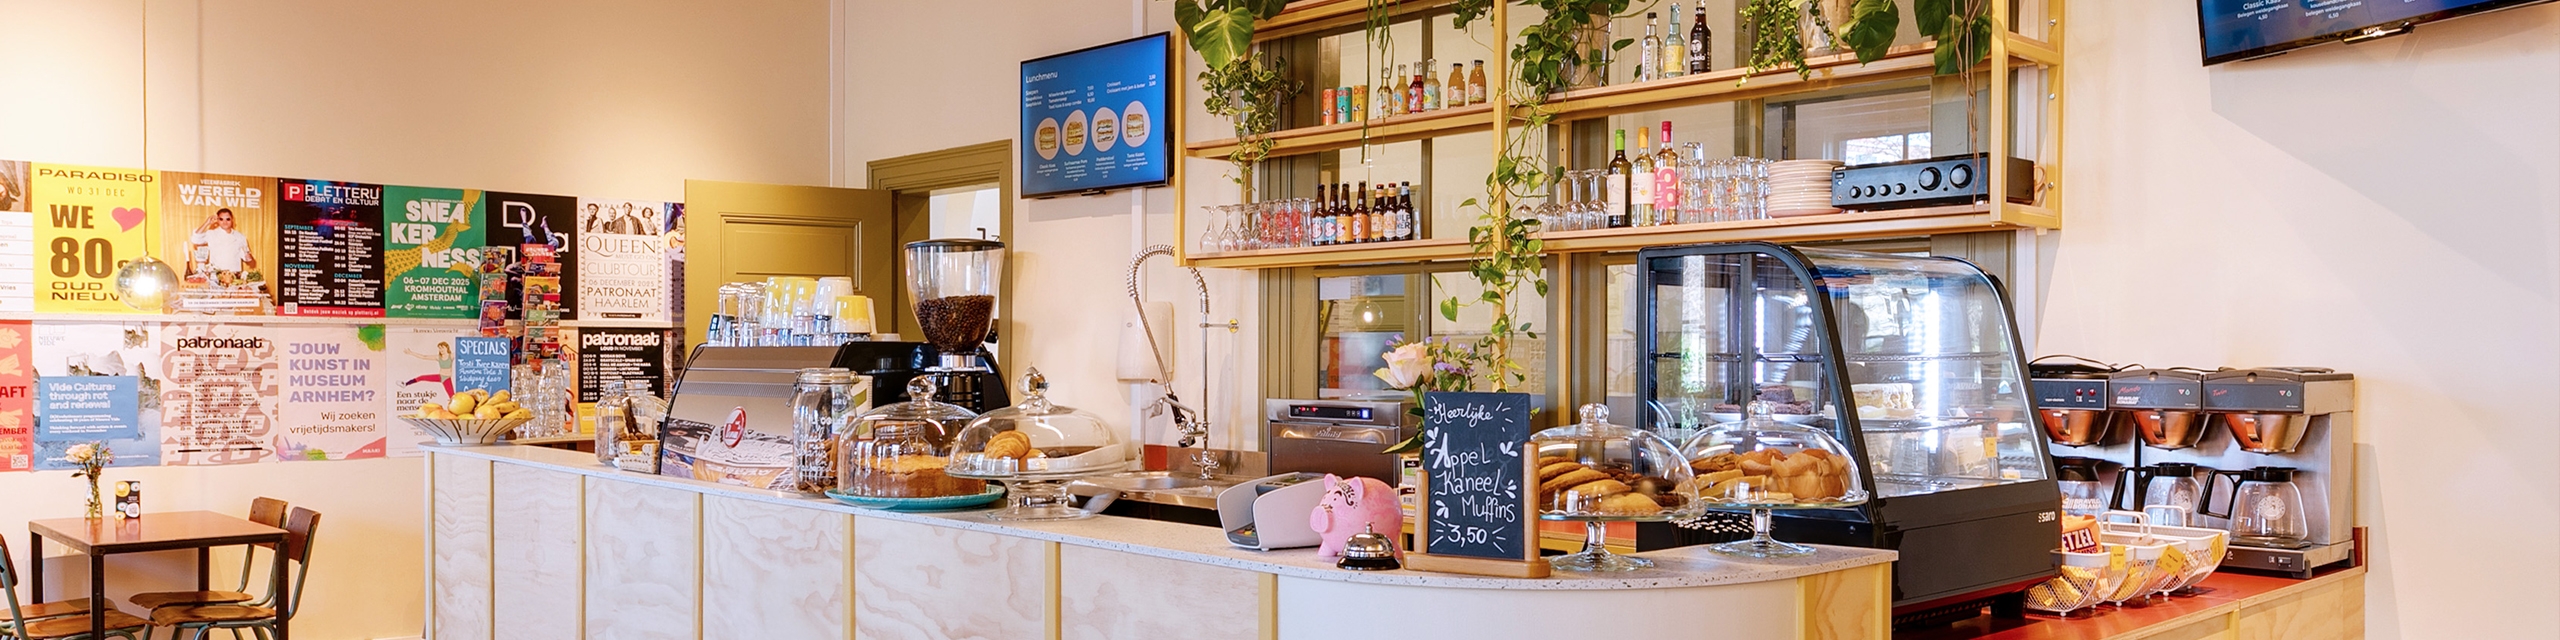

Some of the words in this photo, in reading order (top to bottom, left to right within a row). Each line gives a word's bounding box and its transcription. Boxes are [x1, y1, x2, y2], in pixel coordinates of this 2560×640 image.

[2243, 0, 2264, 10] Classic
[1025, 71, 1058, 84] Lunchmenu
[39, 168, 153, 182] PARADISO
[67, 186, 82, 195] WO
[88, 188, 100, 196] 31
[106, 188, 125, 197] DEC
[178, 184, 262, 199] WERELD
[289, 186, 300, 199] P
[180, 194, 223, 207] VAN
[225, 197, 260, 208] WIE
[305, 195, 331, 203] DEBAT
[333, 196, 343, 204] EN
[345, 198, 380, 206] CULTUUR
[50, 204, 94, 229] WE
[405, 200, 465, 223] SNEA
[391, 222, 437, 245] KER
[585, 235, 656, 257] QUEEN
[421, 247, 480, 269] NESS
[586, 261, 656, 277] CLUBTOUR
[52, 281, 103, 291] OUD
[432, 277, 449, 285] DEC
[451, 278, 470, 286] 2025
[404, 285, 469, 294] KROMHOUTHAL
[587, 287, 657, 298] PATRONAAT
[411, 293, 462, 302] AMSTERDAM
[594, 298, 649, 308] HAARLEM
[177, 336, 262, 351] patronaat
[582, 331, 660, 349] patronaat
[289, 343, 341, 354] JOUW
[460, 339, 508, 356] SPECIALS
[289, 359, 349, 371] KUNST
[353, 359, 370, 370] IN
[289, 375, 366, 386] MUSEUM
[49, 382, 73, 391] Vide
[2118, 385, 2141, 395] Mondo
[49, 392, 92, 401] through
[92, 391, 109, 400] rot
[289, 390, 375, 403] ARNHEM?
[413, 391, 437, 399] stukje
[2212, 389, 2228, 397] Twin
[49, 401, 70, 410] and
[70, 400, 111, 409] renewal
[321, 412, 336, 422] Wij
[338, 411, 376, 420] zoeken
[1433, 402, 1493, 427] Heerlijke
[289, 424, 376, 435] vrijetijdsmakers!
[1462, 494, 1516, 523] Muffins
[2040, 511, 2056, 522] saro
[1447, 523, 1488, 547] 3,50
